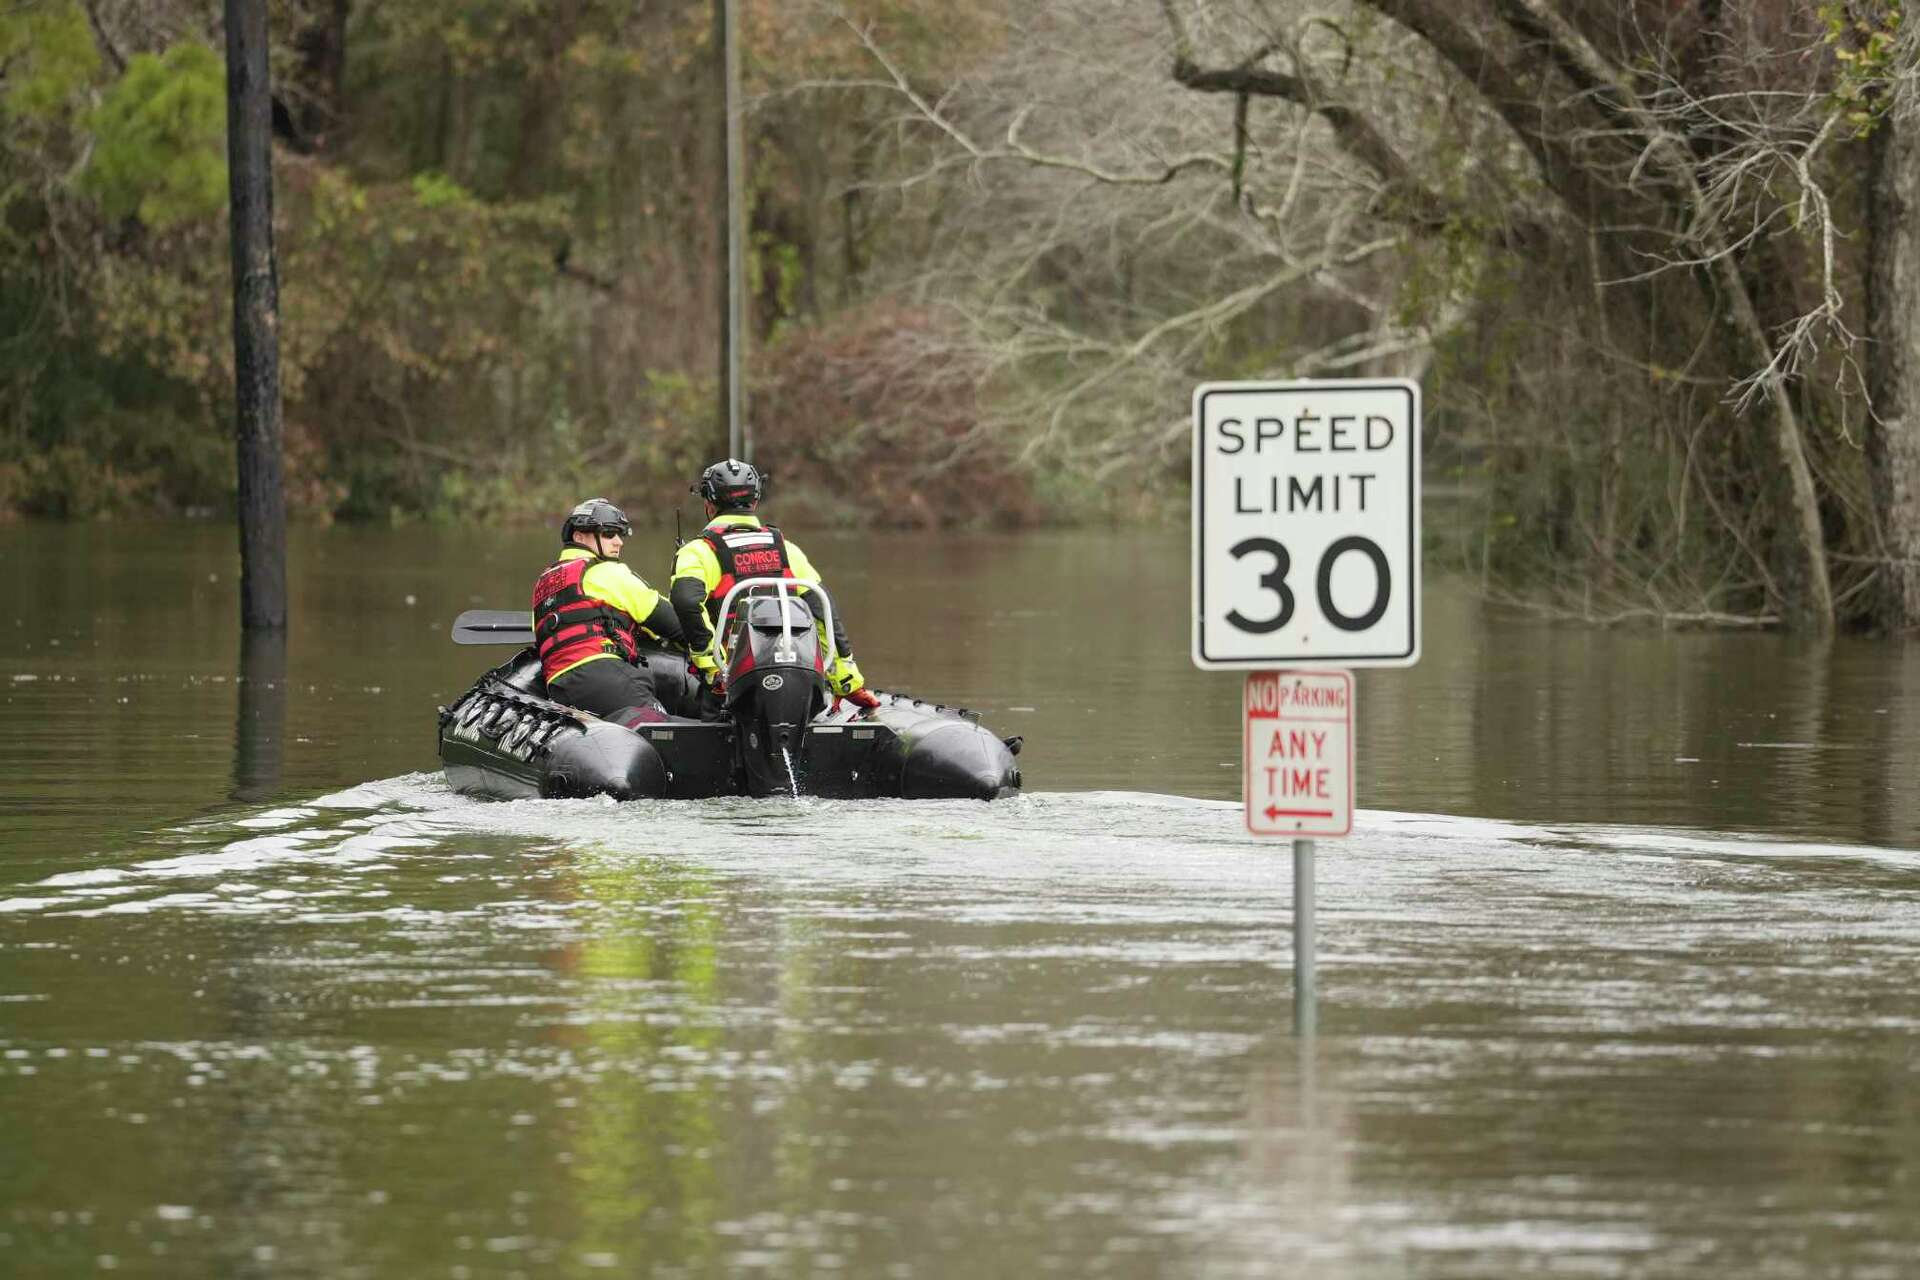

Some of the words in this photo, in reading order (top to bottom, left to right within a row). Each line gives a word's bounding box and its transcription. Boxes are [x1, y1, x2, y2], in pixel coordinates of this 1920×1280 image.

[1218, 415, 1394, 454] SPEED
[1235, 473, 1376, 513] LIMIT
[735, 550, 780, 565] CONROE
[1224, 535, 1392, 634] 30
[1250, 680, 1278, 711] NO
[1279, 686, 1345, 708] PARKING
[1267, 729, 1327, 759] ANY
[1264, 766, 1331, 799] TIME
